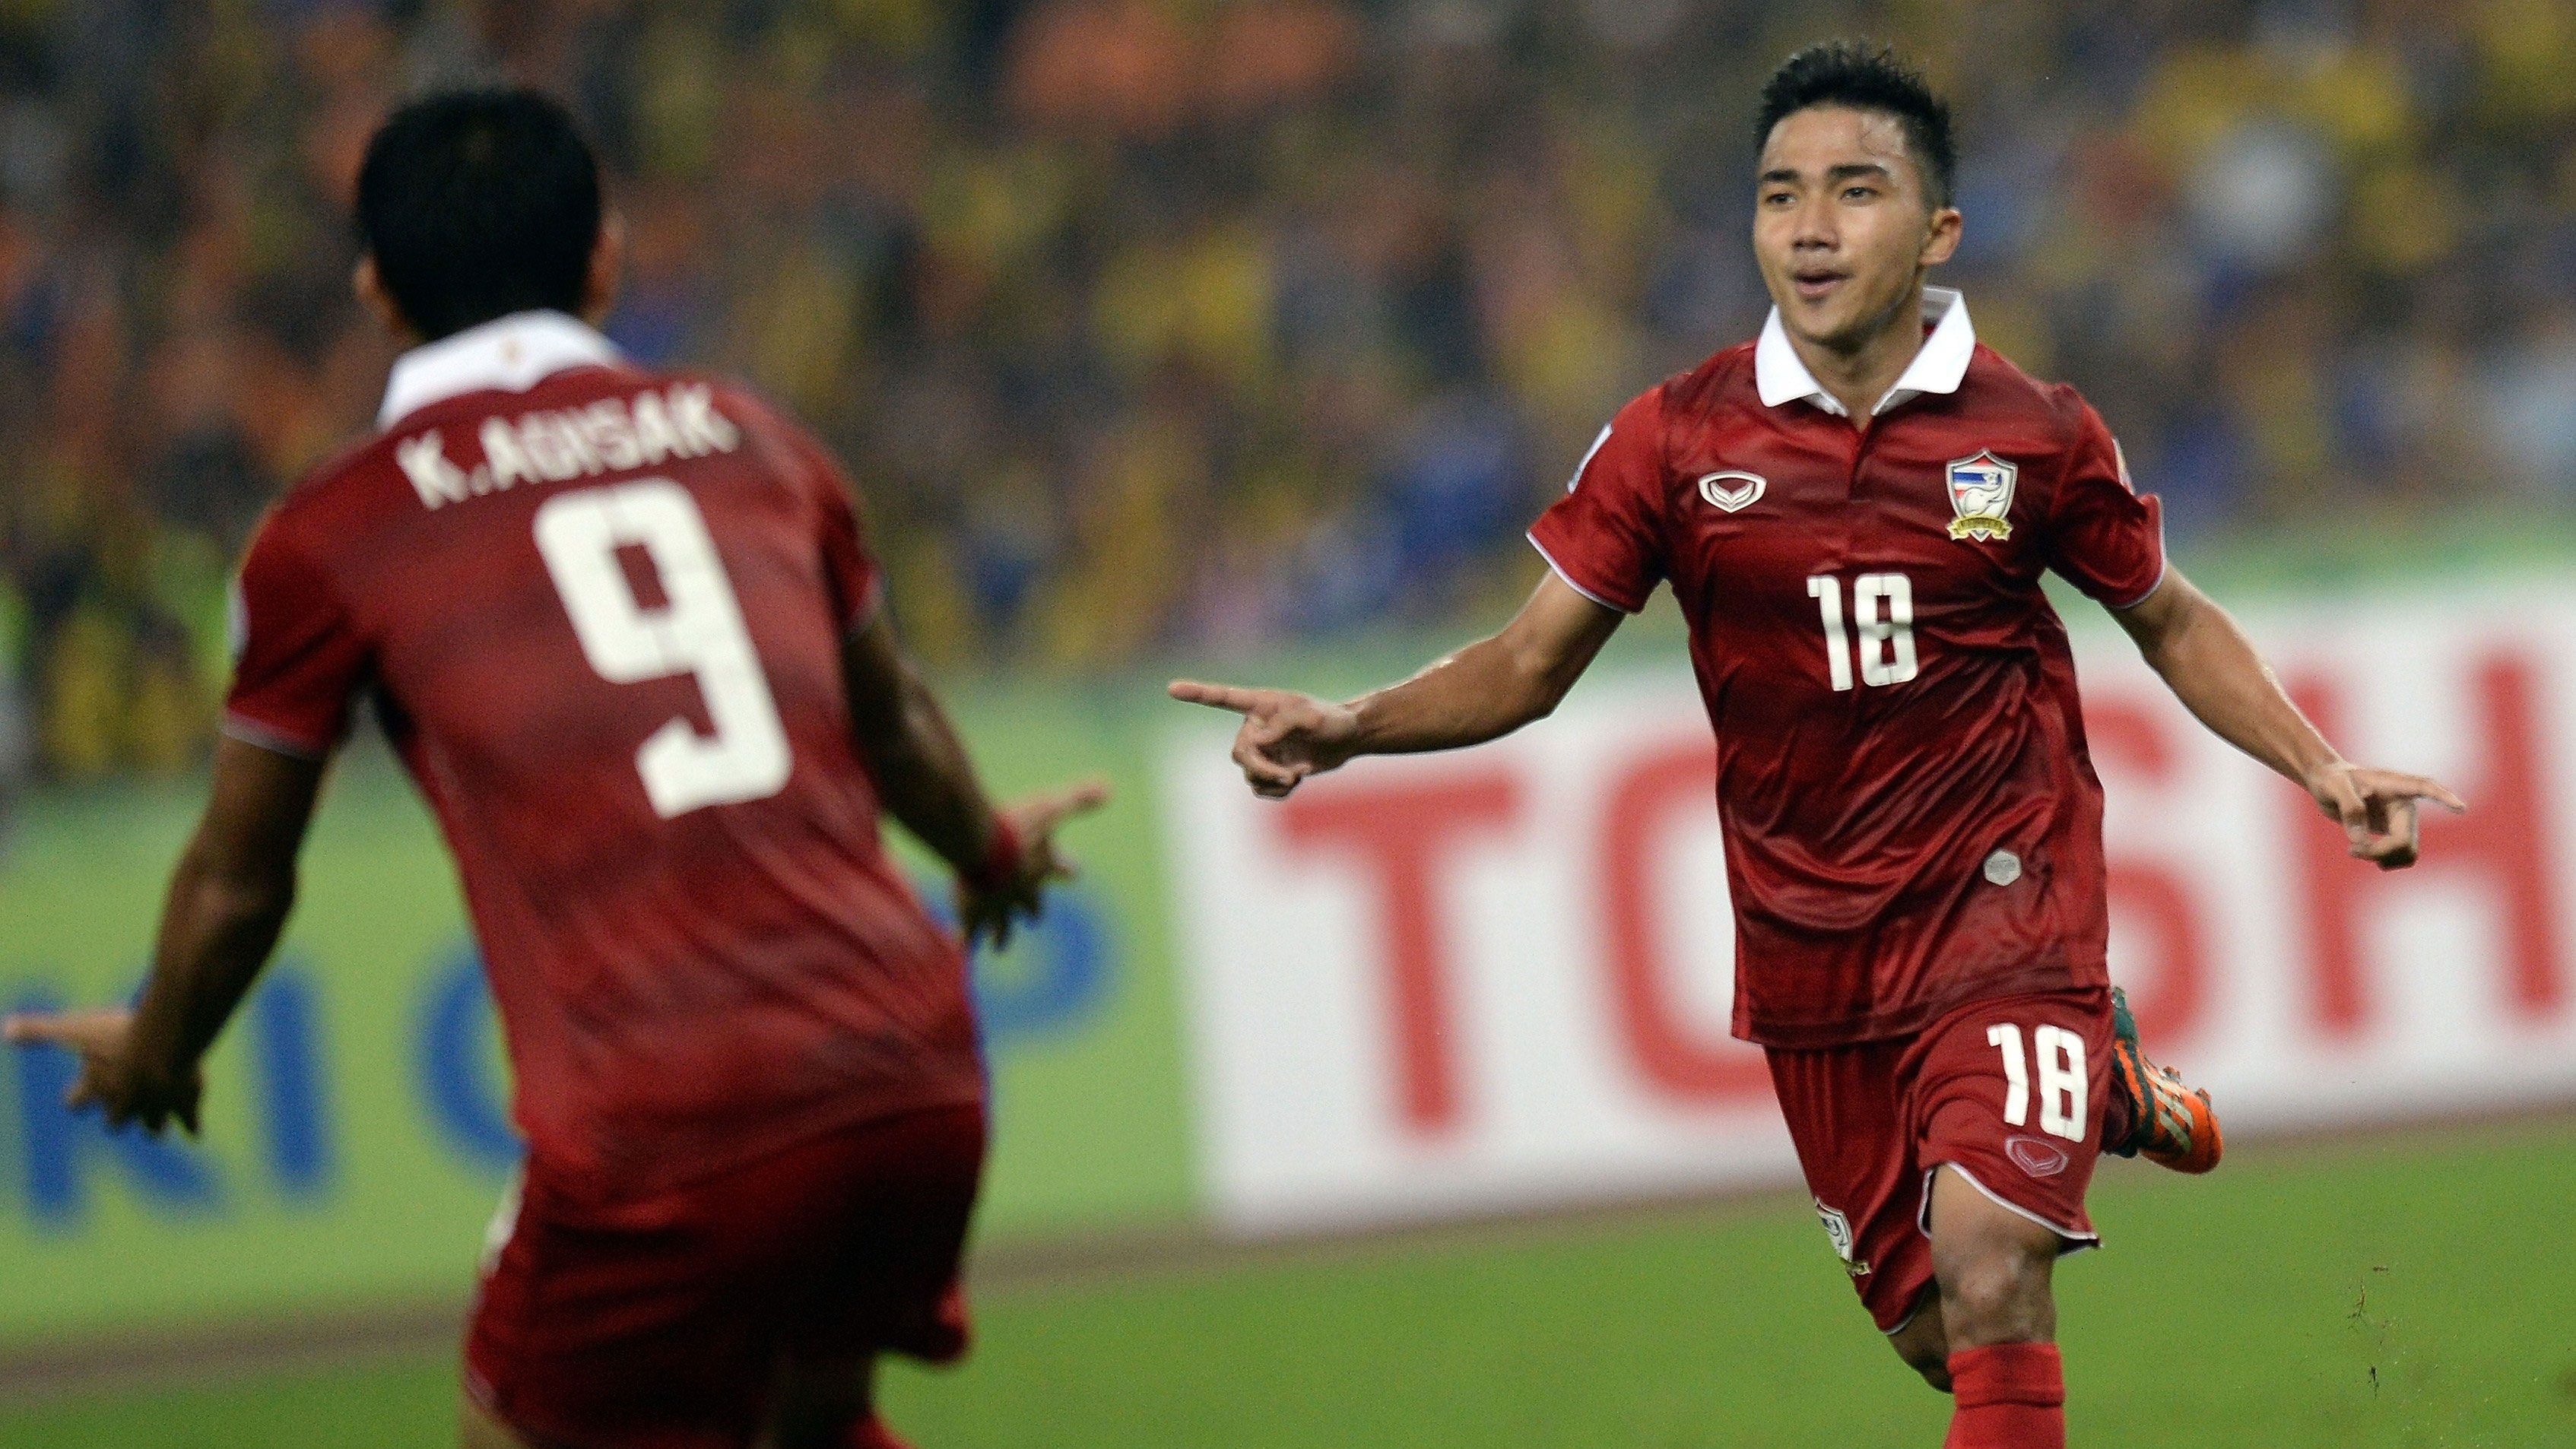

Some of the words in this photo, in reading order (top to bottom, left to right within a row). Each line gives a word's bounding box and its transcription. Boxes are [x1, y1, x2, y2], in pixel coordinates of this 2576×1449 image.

[533, 477, 793, 818] 9
[1806, 572, 1919, 692] 18
[1986, 1023, 2089, 1143] 18
